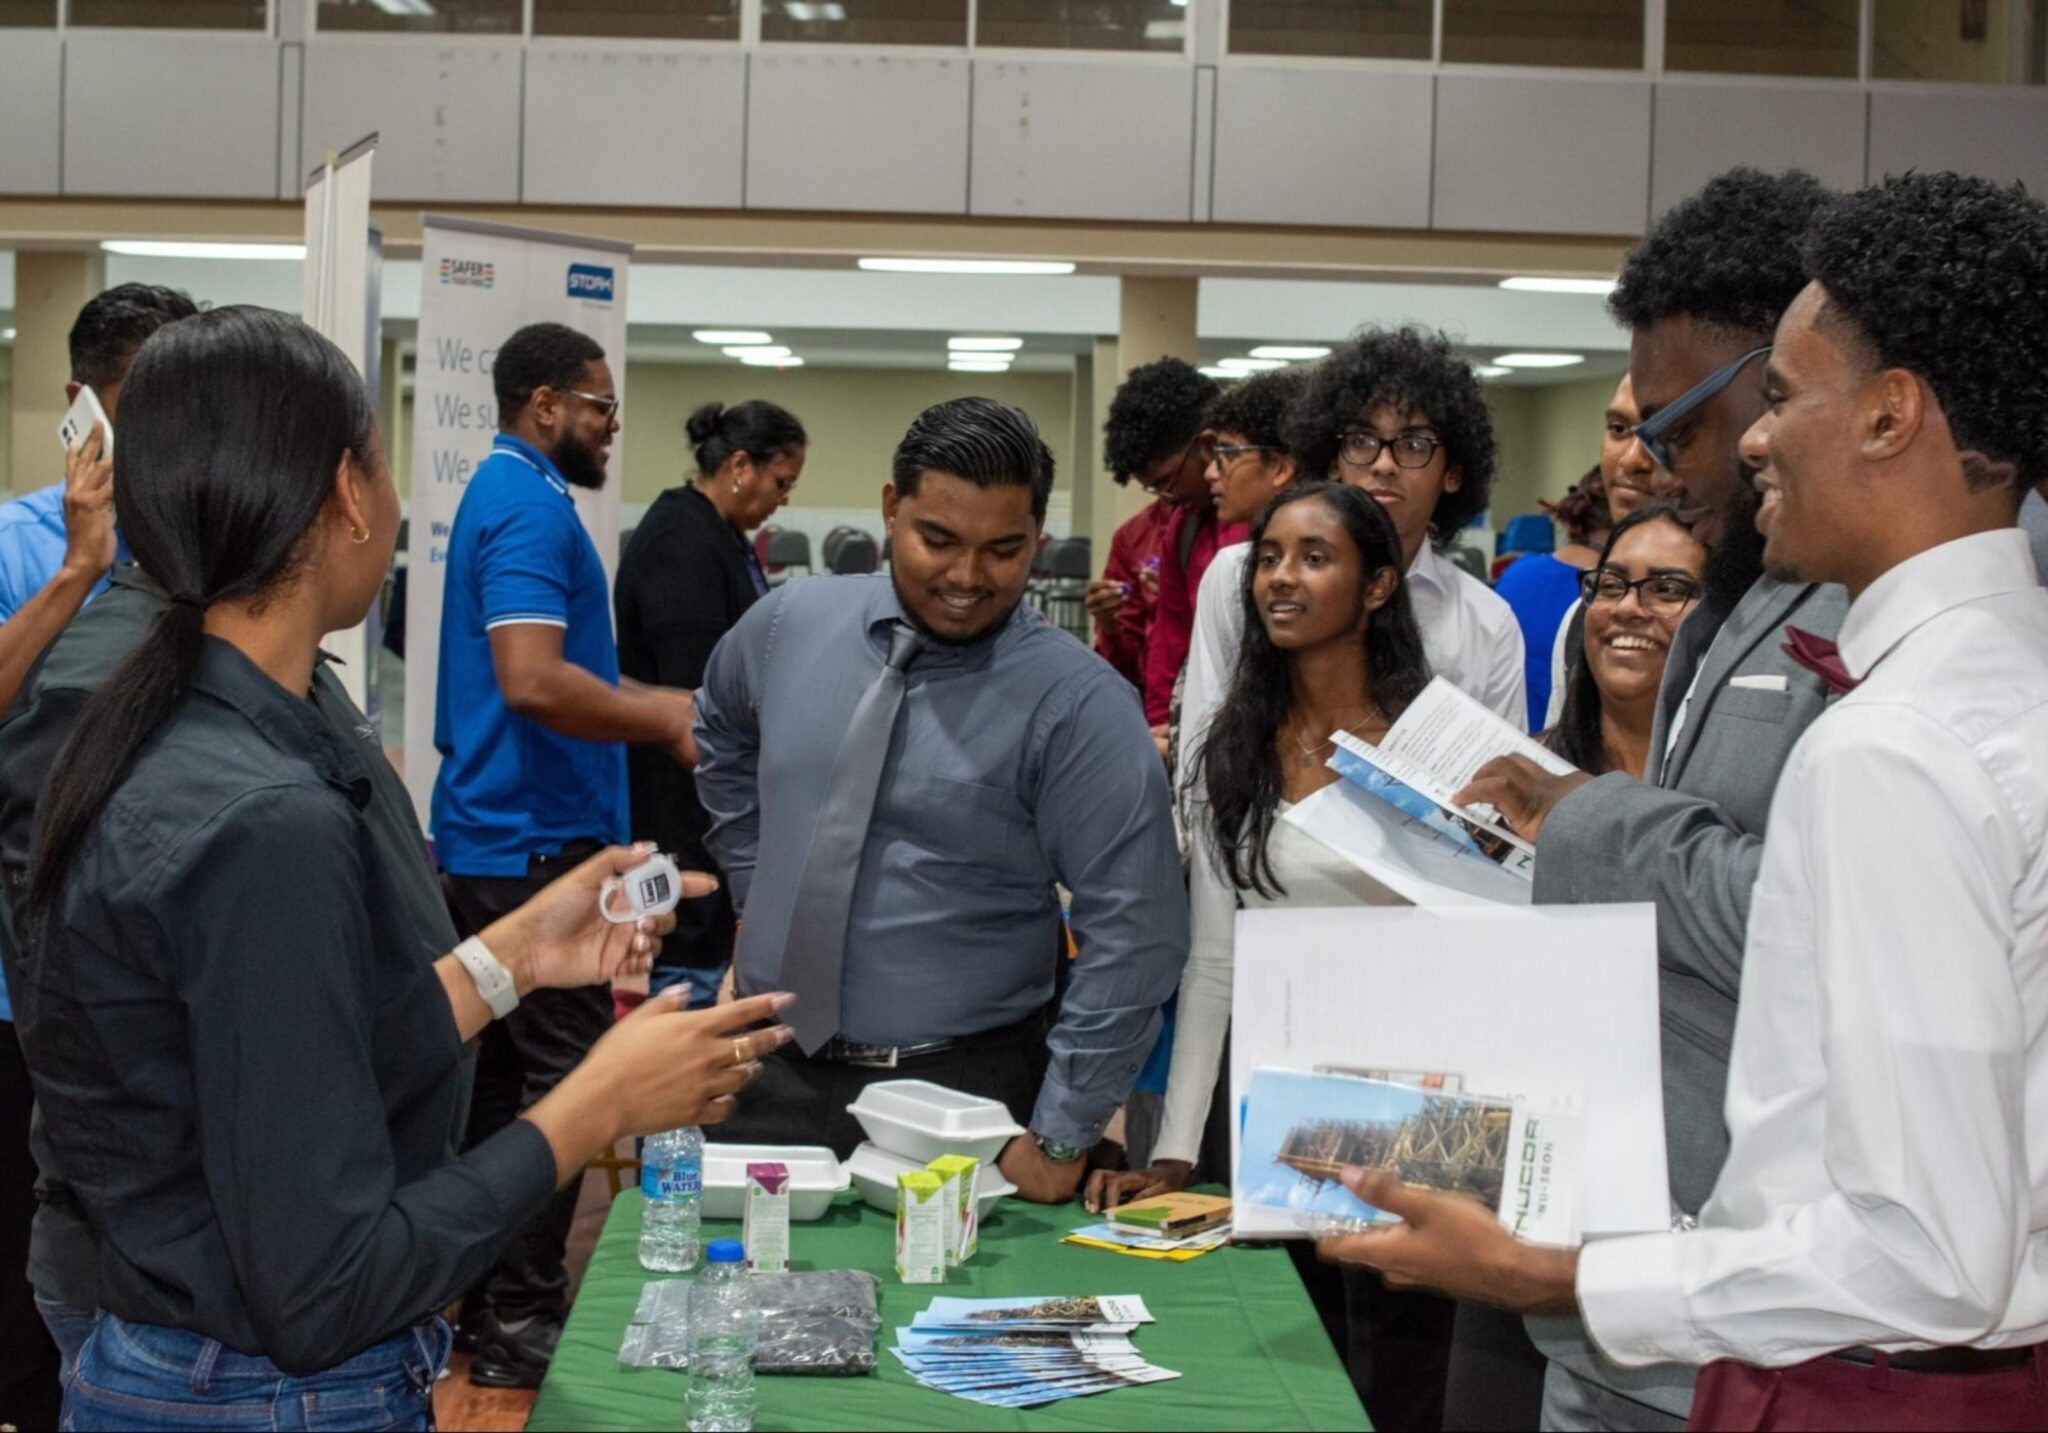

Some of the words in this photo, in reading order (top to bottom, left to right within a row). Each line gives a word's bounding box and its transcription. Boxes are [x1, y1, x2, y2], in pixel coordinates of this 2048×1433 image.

[452, 259, 484, 276] SAFER
[437, 336, 472, 374] We
[435, 394, 471, 429] We
[433, 450, 469, 484] We
[673, 1171, 698, 1181] Blue
[1513, 1118, 1539, 1237] NUCOR
[1538, 1141, 1555, 1215] NU-IRON
